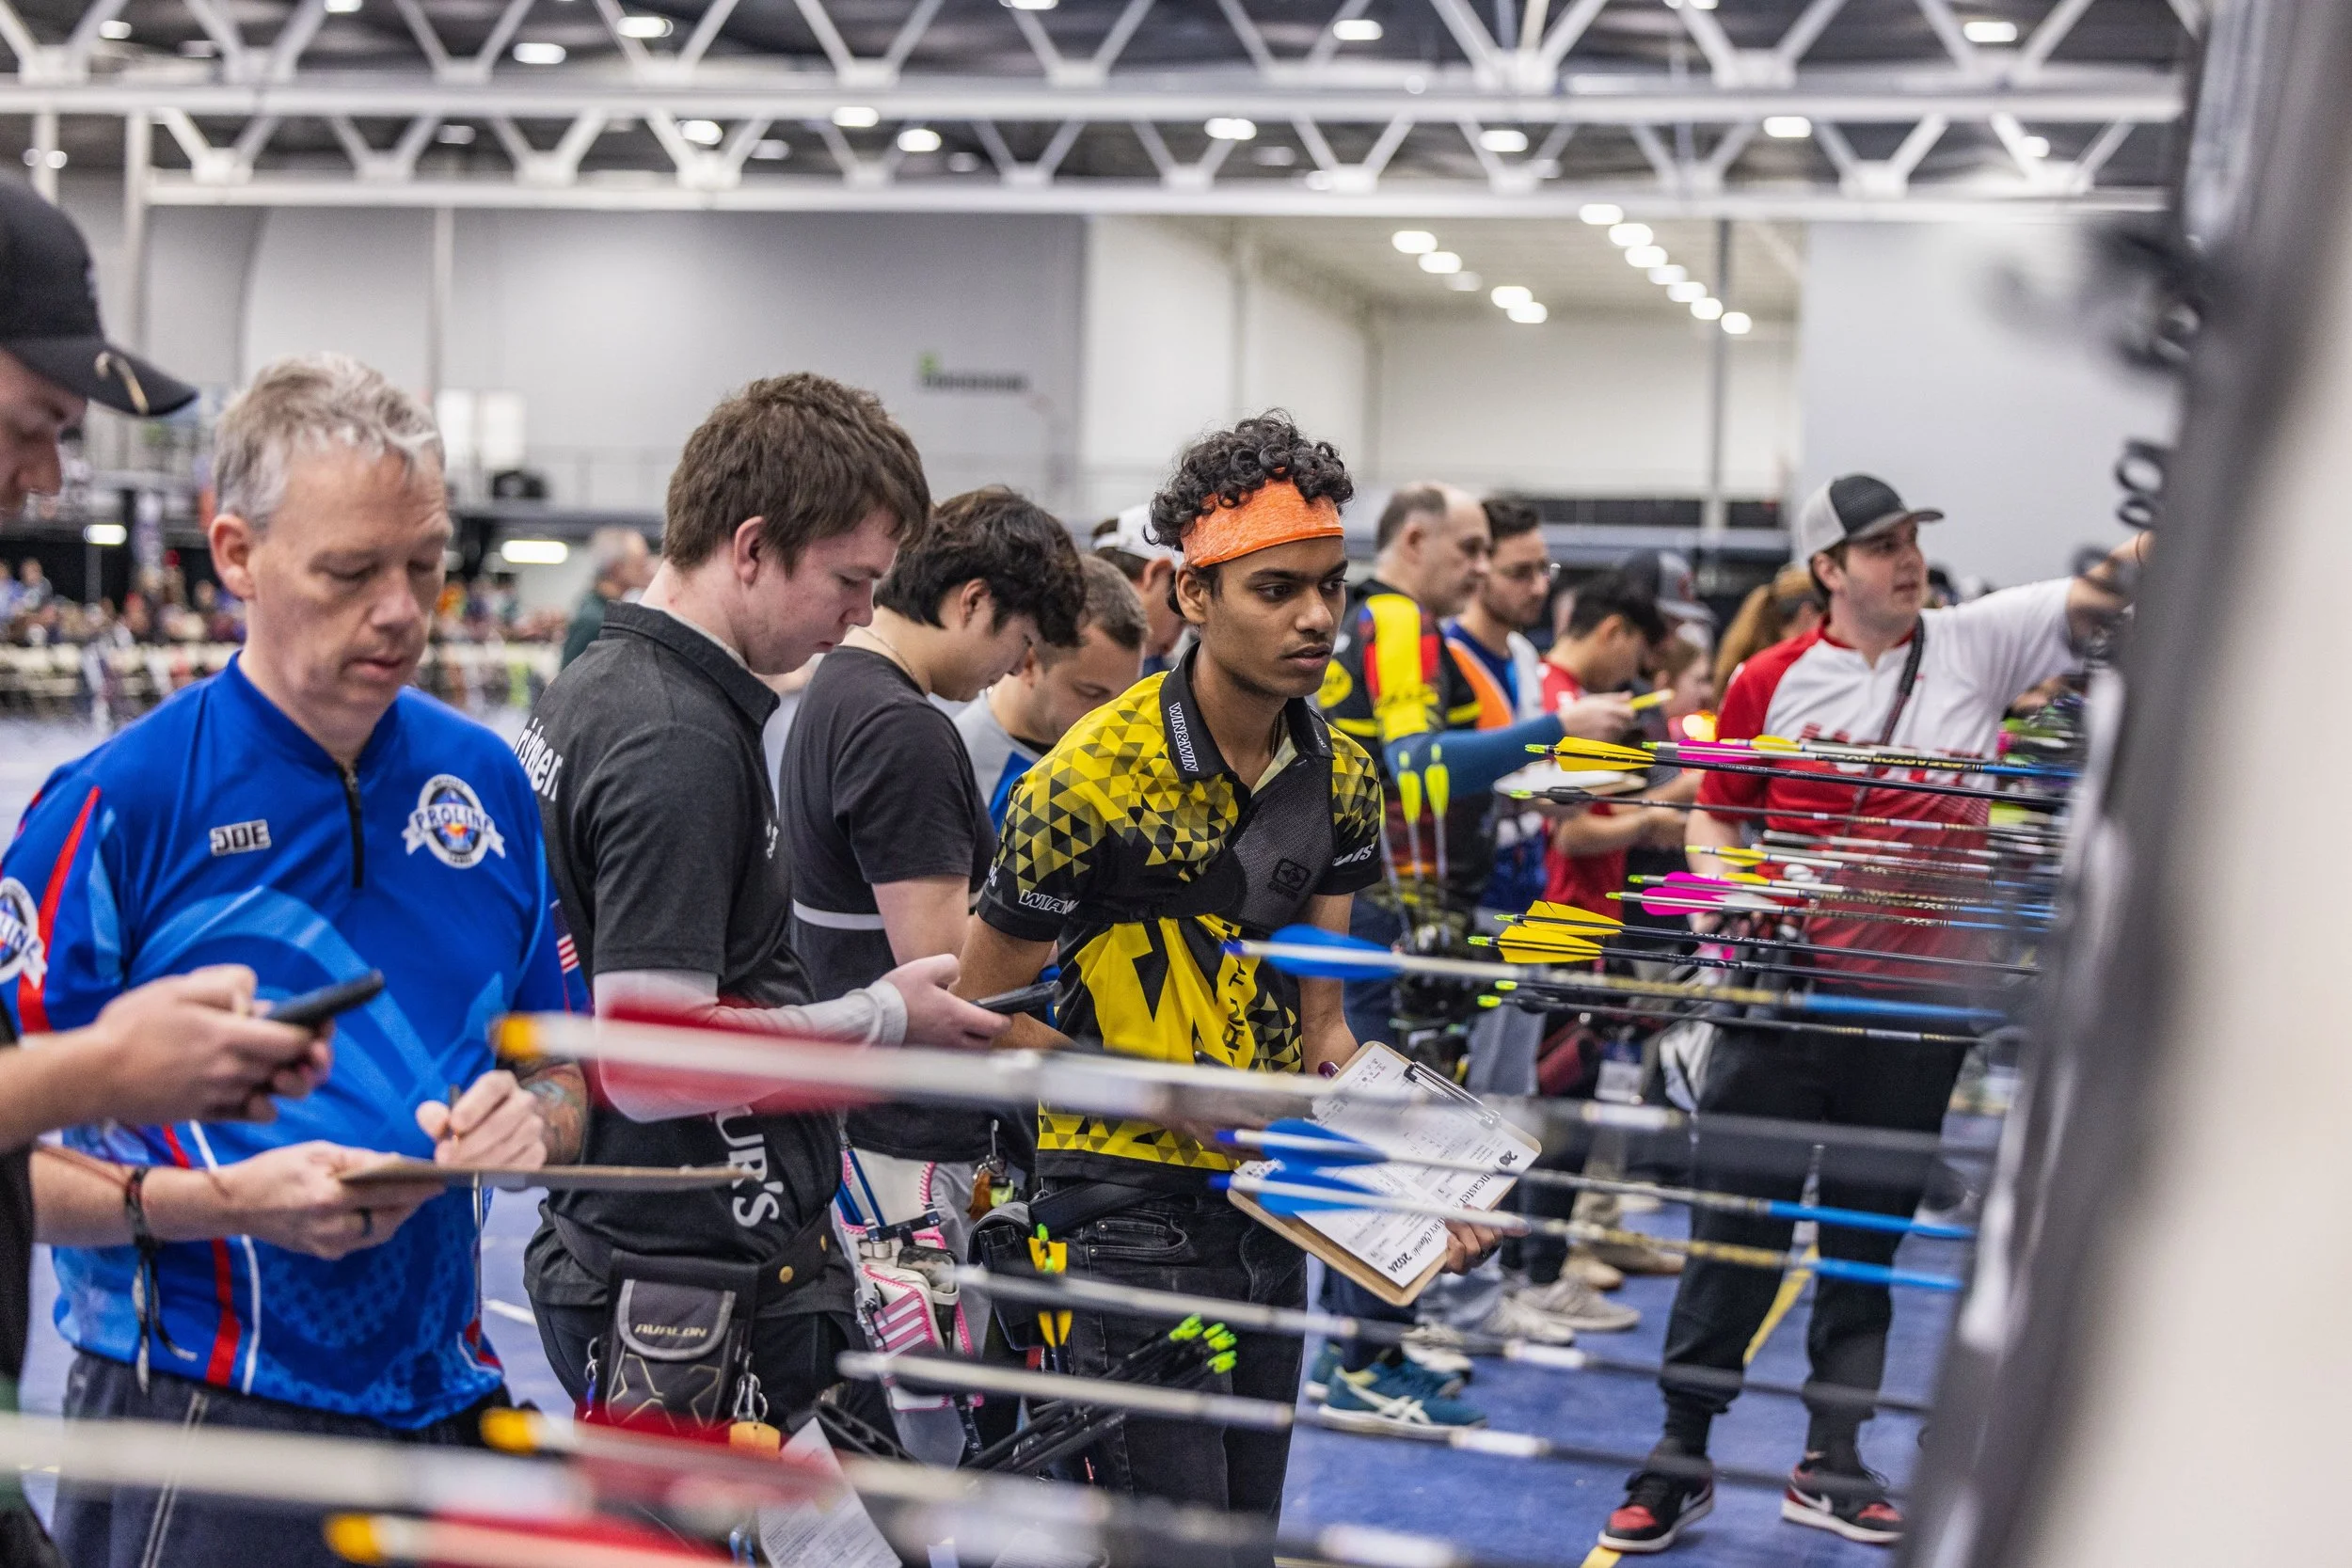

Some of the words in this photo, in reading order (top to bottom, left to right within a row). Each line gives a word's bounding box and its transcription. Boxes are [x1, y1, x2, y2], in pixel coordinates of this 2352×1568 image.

[1168, 702, 1200, 772] WIN&WIN
[210, 820, 271, 856] JOE
[716, 1104, 784, 1227] UR'S
[1387, 1251, 1413, 1274] 2024
